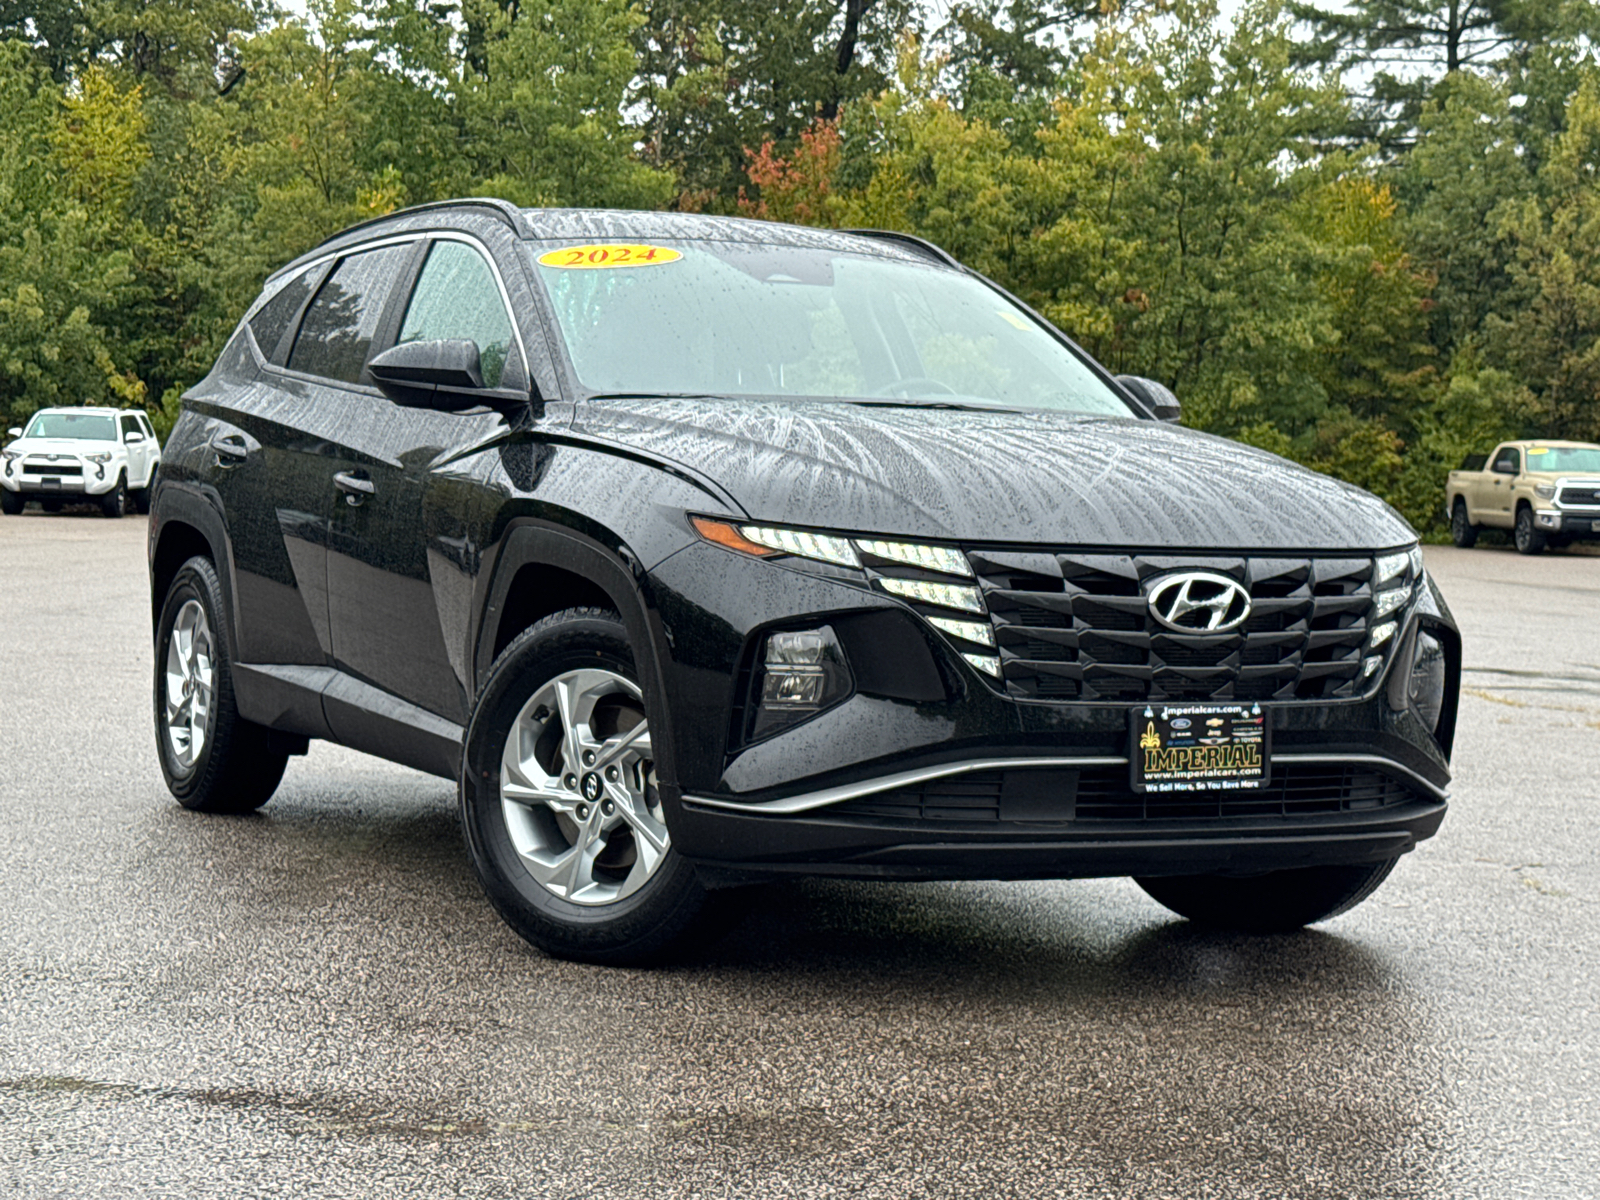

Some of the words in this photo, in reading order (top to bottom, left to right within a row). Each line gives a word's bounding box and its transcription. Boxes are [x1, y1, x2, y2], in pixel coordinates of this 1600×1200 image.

[565, 248, 658, 266] 2024
[1144, 744, 1261, 772] IMPERIAL
[1144, 768, 1262, 780] www.imperialcars.com
[1145, 783, 1158, 792] We
[1159, 783, 1173, 791] Sell
[1196, 781, 1206, 790] So
[1207, 781, 1221, 790] You
[1240, 780, 1259, 788] More
